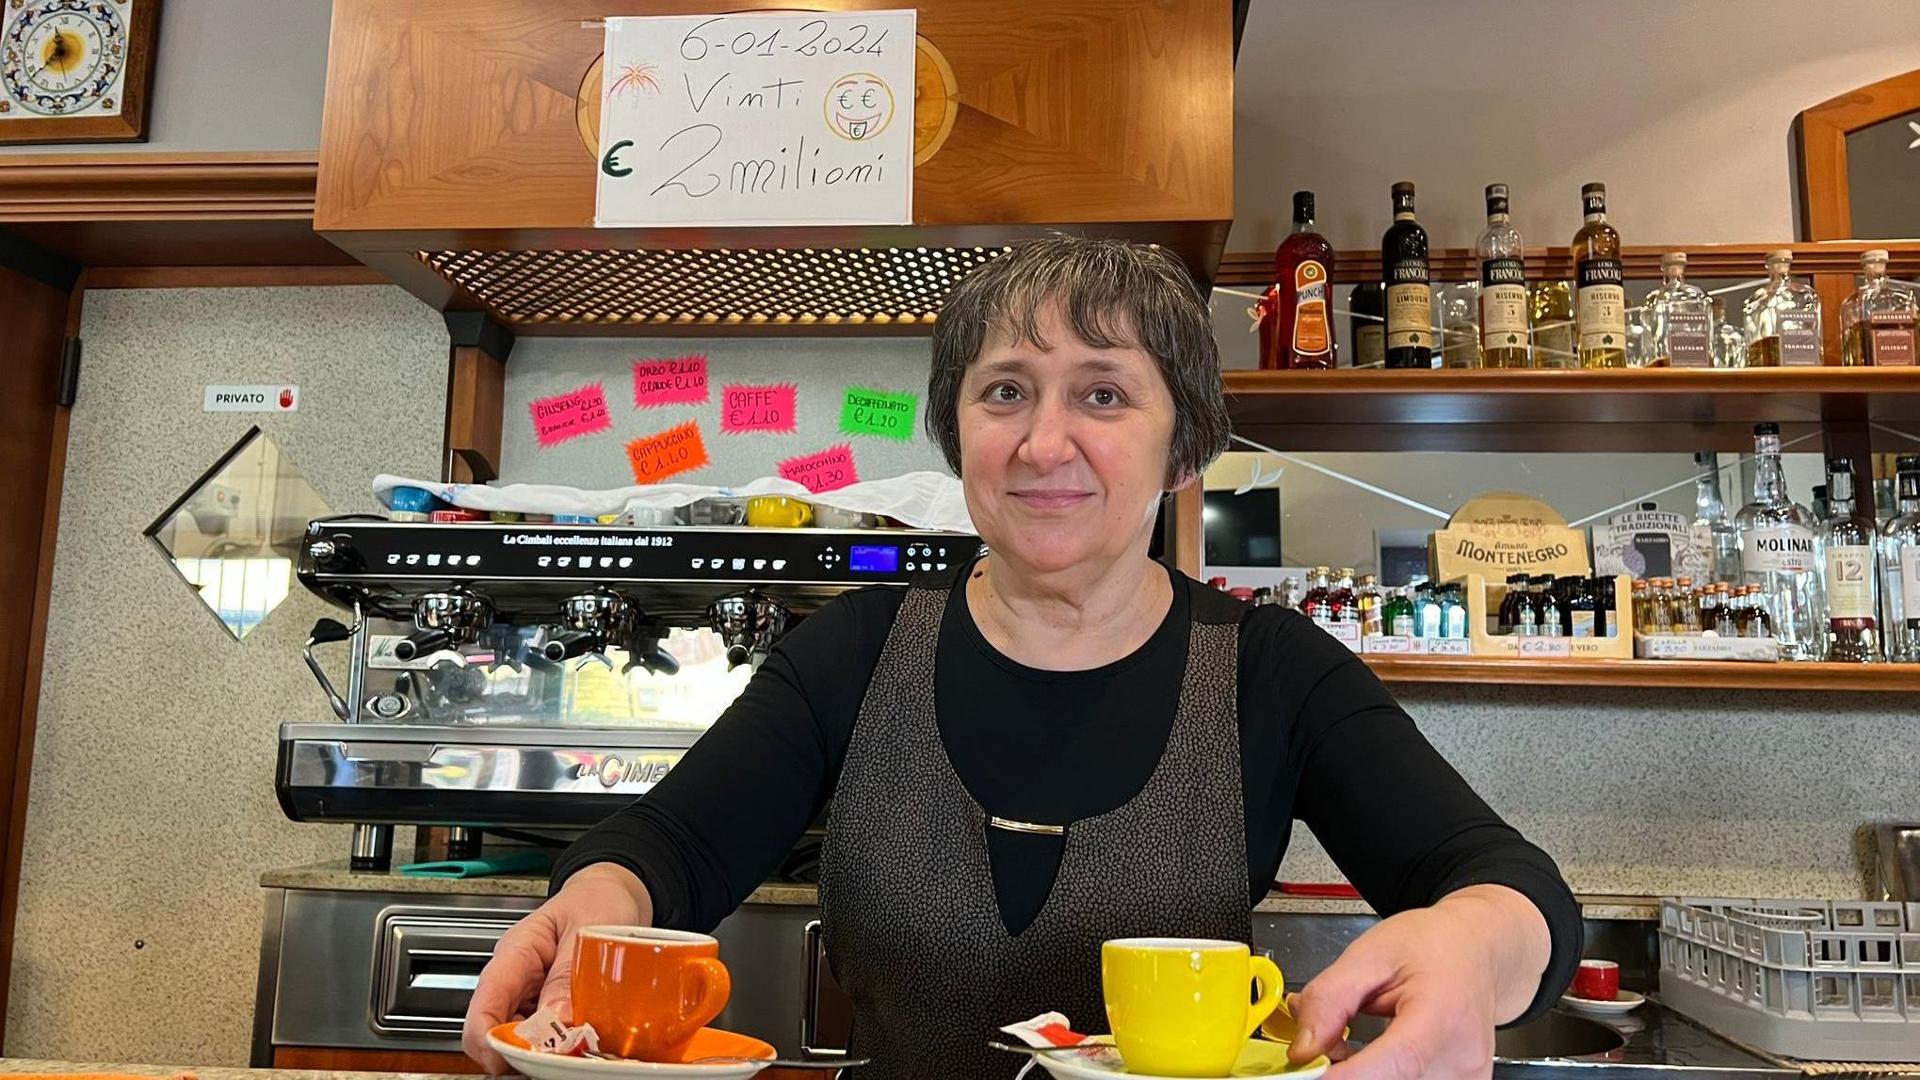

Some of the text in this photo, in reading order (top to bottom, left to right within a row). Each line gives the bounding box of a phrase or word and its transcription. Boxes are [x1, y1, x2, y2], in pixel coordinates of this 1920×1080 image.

[680, 18, 889, 60] 6-01-2024
[684, 72, 804, 113] Vinti
[602, 140, 634, 177] €
[215, 393, 265, 404] PRIVATO
[1621, 512, 1681, 523] LE RICETTE
[1615, 521, 1688, 534] TRADIZIONALI
[502, 535, 674, 547] La Cimbali eccellenza italiana dal 1912
[1836, 560, 1864, 581] 12
[578, 762, 598, 777] LA
